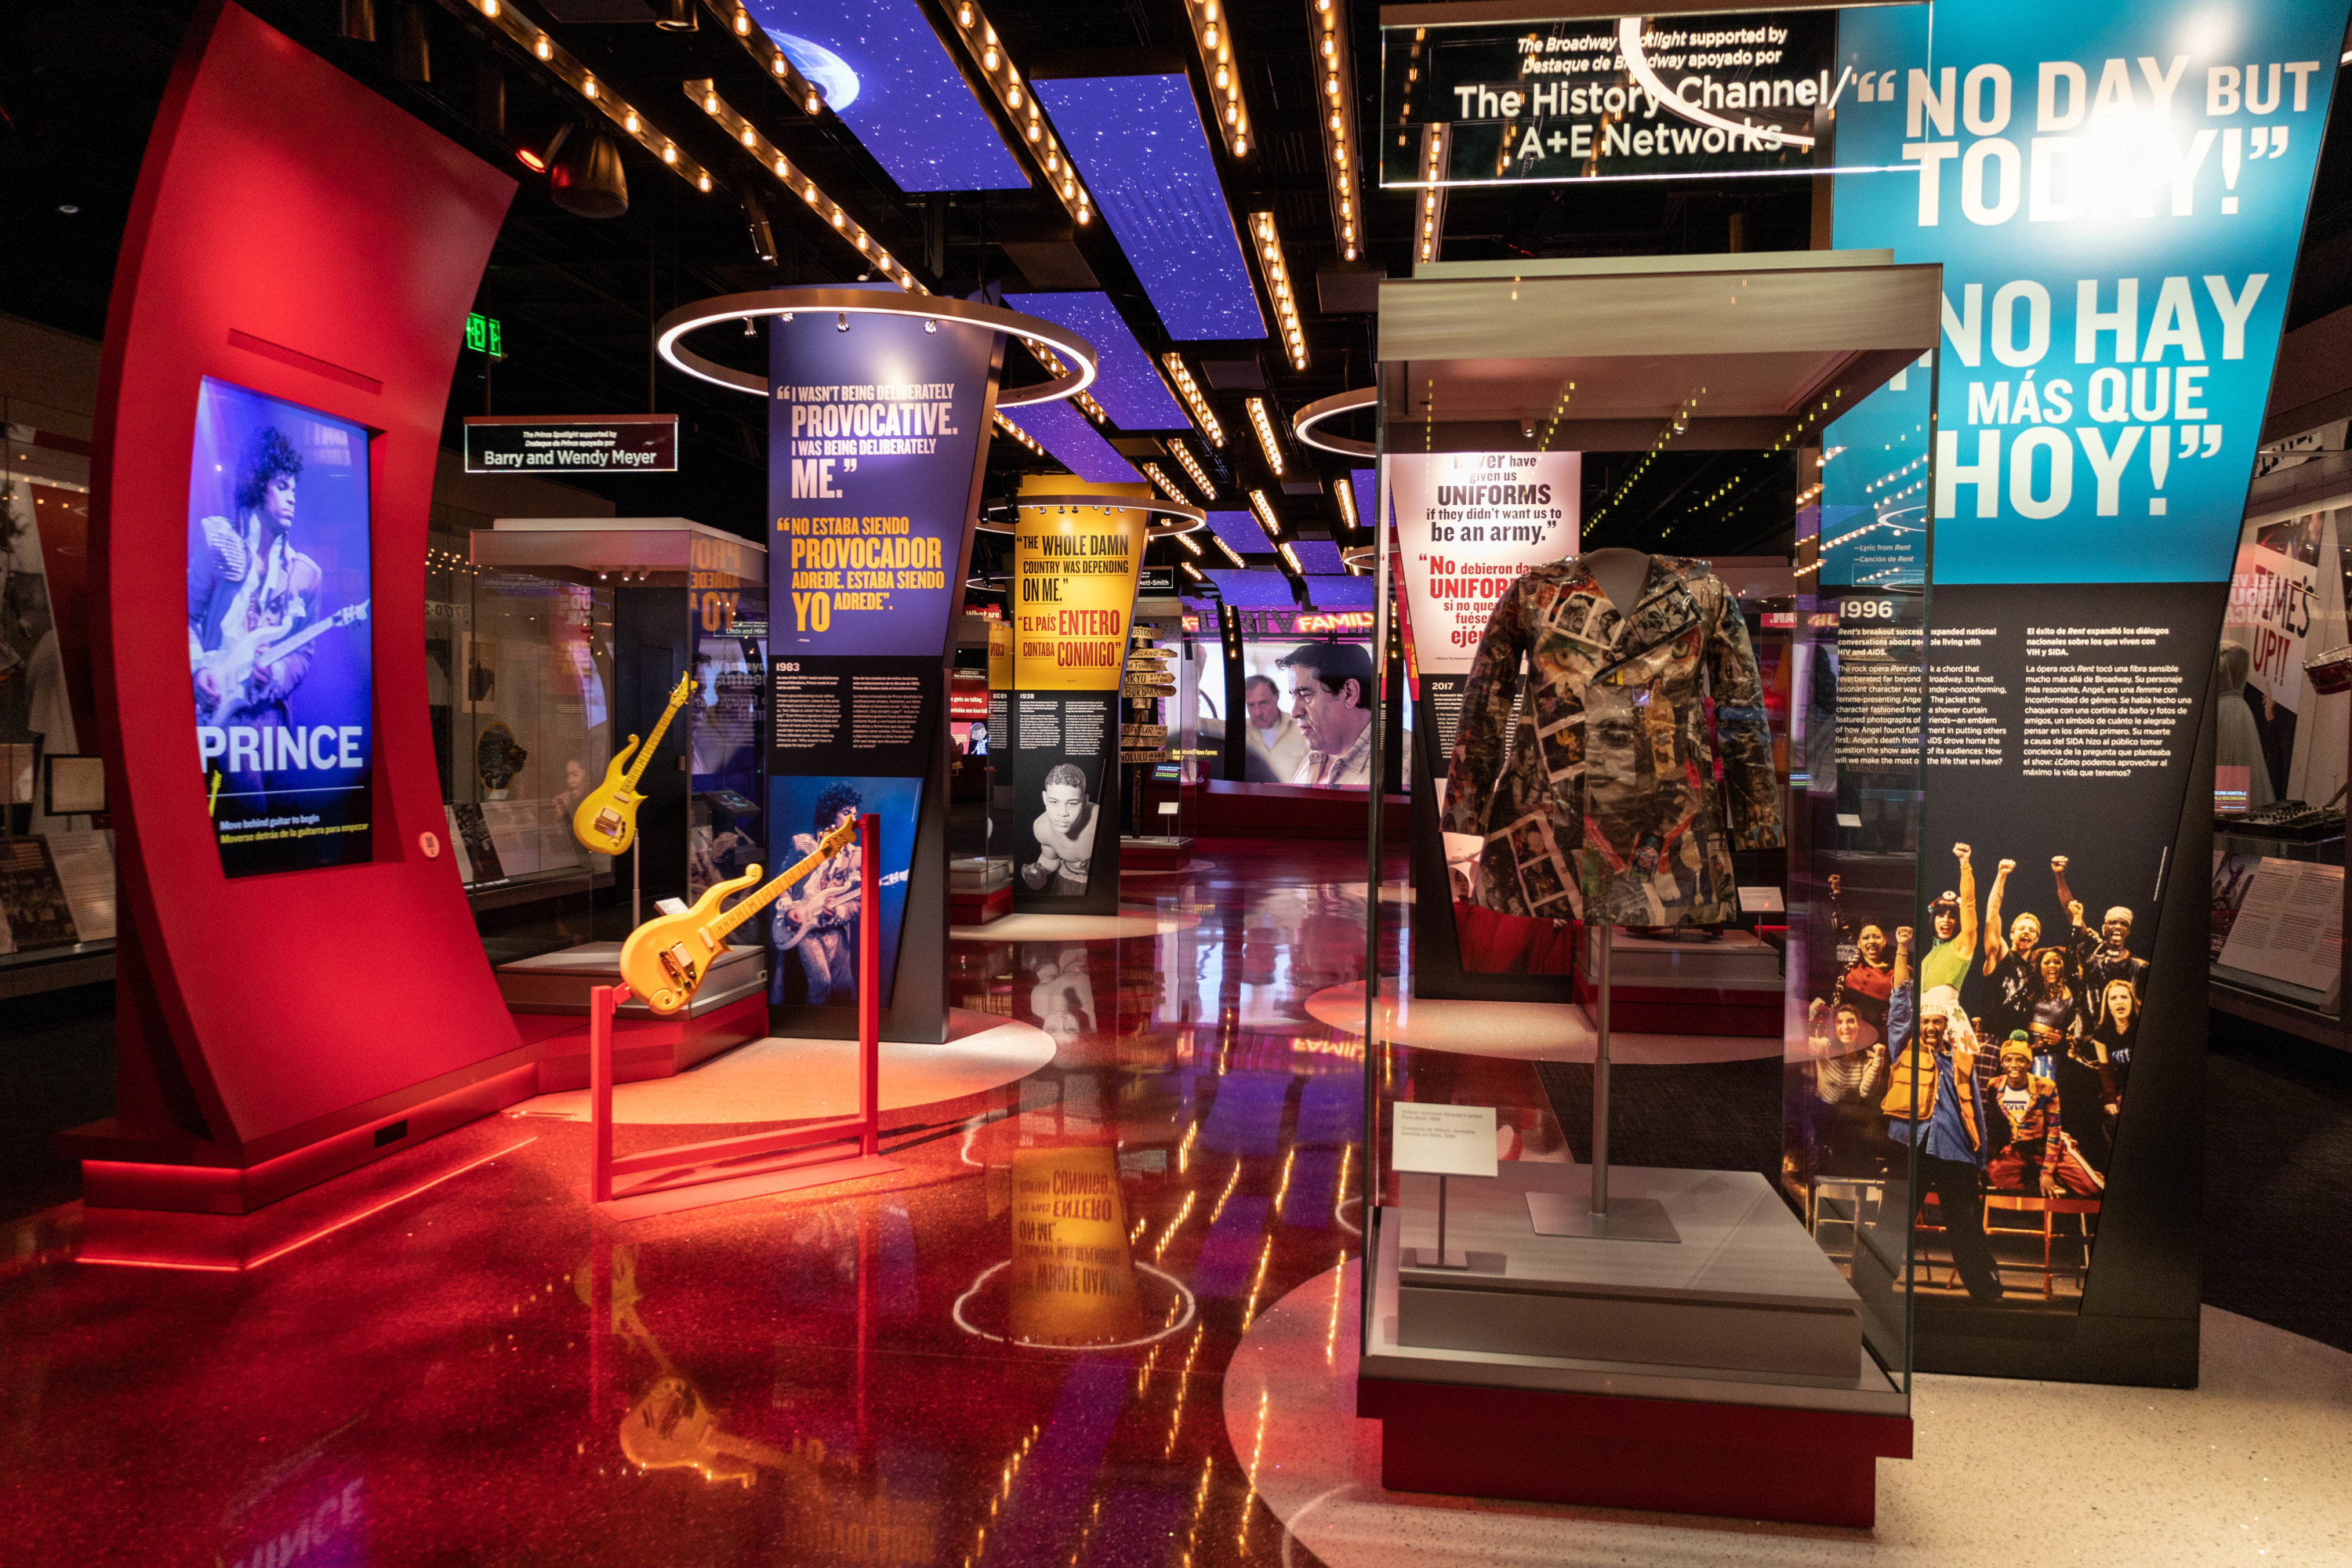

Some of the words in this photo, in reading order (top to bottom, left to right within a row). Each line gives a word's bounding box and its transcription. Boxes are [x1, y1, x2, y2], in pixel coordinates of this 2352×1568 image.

[1518, 38, 1543, 53] The
[1546, 37, 1617, 53] Broadway
[1690, 28, 1765, 49] supported
[1769, 27, 1788, 44] by
[1523, 57, 1589, 75] Destaque
[1592, 55, 1610, 71] de
[1613, 53, 1686, 71] Brdway
[1689, 51, 1752, 69] apoyado
[1755, 50, 1782, 65] por
[1455, 86, 1520, 118] The
[1534, 82, 1662, 118] History
[1857, 64, 2013, 138] “NO
[2037, 56, 2191, 132] DAY
[2206, 60, 2320, 116] BUT
[1518, 125, 1592, 158] A+E
[1606, 117, 1783, 157] Networks
[1903, 125, 2290, 227] TODY!”
[2074, 273, 2270, 365] HAY
[777, 386, 796, 402] “I
[798, 385, 840, 402] WASN'T
[843, 385, 874, 401] BEING
[877, 383, 954, 400] DELIBERATELY
[1968, 370, 2073, 424] MÁS
[2087, 366, 2209, 423] QUE
[792, 402, 957, 437] PROVOCATIVE.
[792, 441, 796, 456] I
[798, 441, 822, 456] WAS
[824, 440, 857, 456] BEING
[859, 438, 936, 455] DELIBERATELY
[485, 450, 524, 467] Barry
[527, 450, 554, 464] and
[557, 450, 608, 466] Wendy
[612, 450, 657, 466] Meyer
[1509, 455, 1536, 466] have
[792, 459, 857, 499] ME.”
[1470, 471, 1501, 484] given
[1504, 470, 1517, 481] us
[1935, 424, 2223, 520] HOY!”
[1438, 484, 1551, 506] UNIFORMS
[777, 517, 809, 535] “NO
[812, 517, 859, 535] ESTABA
[862, 517, 909, 535] SIENDO
[1427, 509, 1436, 520] if
[1439, 509, 1464, 521] they
[1467, 509, 1501, 520] didn't
[1502, 509, 1530, 520] want
[1534, 510, 1548, 519] us
[1549, 509, 1562, 519] to
[1432, 522, 1454, 542] be
[1461, 525, 1483, 542] an
[1490, 521, 1556, 545] army.”
[792, 537, 942, 569] PROVOCADOR
[1017, 535, 1038, 550] “THE
[1043, 535, 1086, 557] WHOLE
[1091, 535, 1128, 556] DAMN
[1023, 561, 1060, 575] COUNTRY
[1063, 561, 1082, 574] WAS
[1083, 560, 1128, 574] DEPENDING
[1419, 554, 1455, 575] “No
[1461, 563, 1512, 574] debieron
[1515, 562, 1531, 574] da
[792, 571, 844, 590] ADREDE.
[847, 572, 895, 590] ESTABA
[898, 571, 944, 589] SIENDO
[1023, 579, 1039, 601] ON
[1042, 579, 1069, 601] ME.”
[1430, 578, 1517, 598] UNIFOR
[792, 592, 830, 633] YO
[834, 592, 893, 610] ADREDE”.
[1443, 600, 1453, 611] si
[1457, 602, 1469, 611] no
[1473, 602, 1497, 613] que
[1840, 601, 1893, 619] 1996
[1018, 616, 1034, 631] “EL
[1036, 613, 1055, 631] PAÍS
[1058, 610, 1120, 636] ENTERO
[1298, 612, 1374, 631] FAMILY
[1456, 612, 1490, 624] fuése
[1451, 626, 1484, 648] ejé
[2087, 627, 2122, 636] expandió
[2136, 627, 2169, 636] diálogos
[1023, 641, 1054, 656] CONTABA
[1058, 641, 1121, 667] CONMIGO”.
[776, 662, 800, 671] 1983
[1125, 686, 1159, 696] BURBANK
[197, 724, 363, 773] PRINCE
[220, 821, 242, 830] Move
[242, 818, 269, 829] behind
[270, 817, 291, 828] guitar
[300, 814, 320, 824] begin
[220, 833, 254, 844] Moverse
[255, 831, 278, 840] detrás
[298, 827, 325, 838] guitarra
[325, 826, 340, 835] para
[341, 823, 368, 833] empezar
